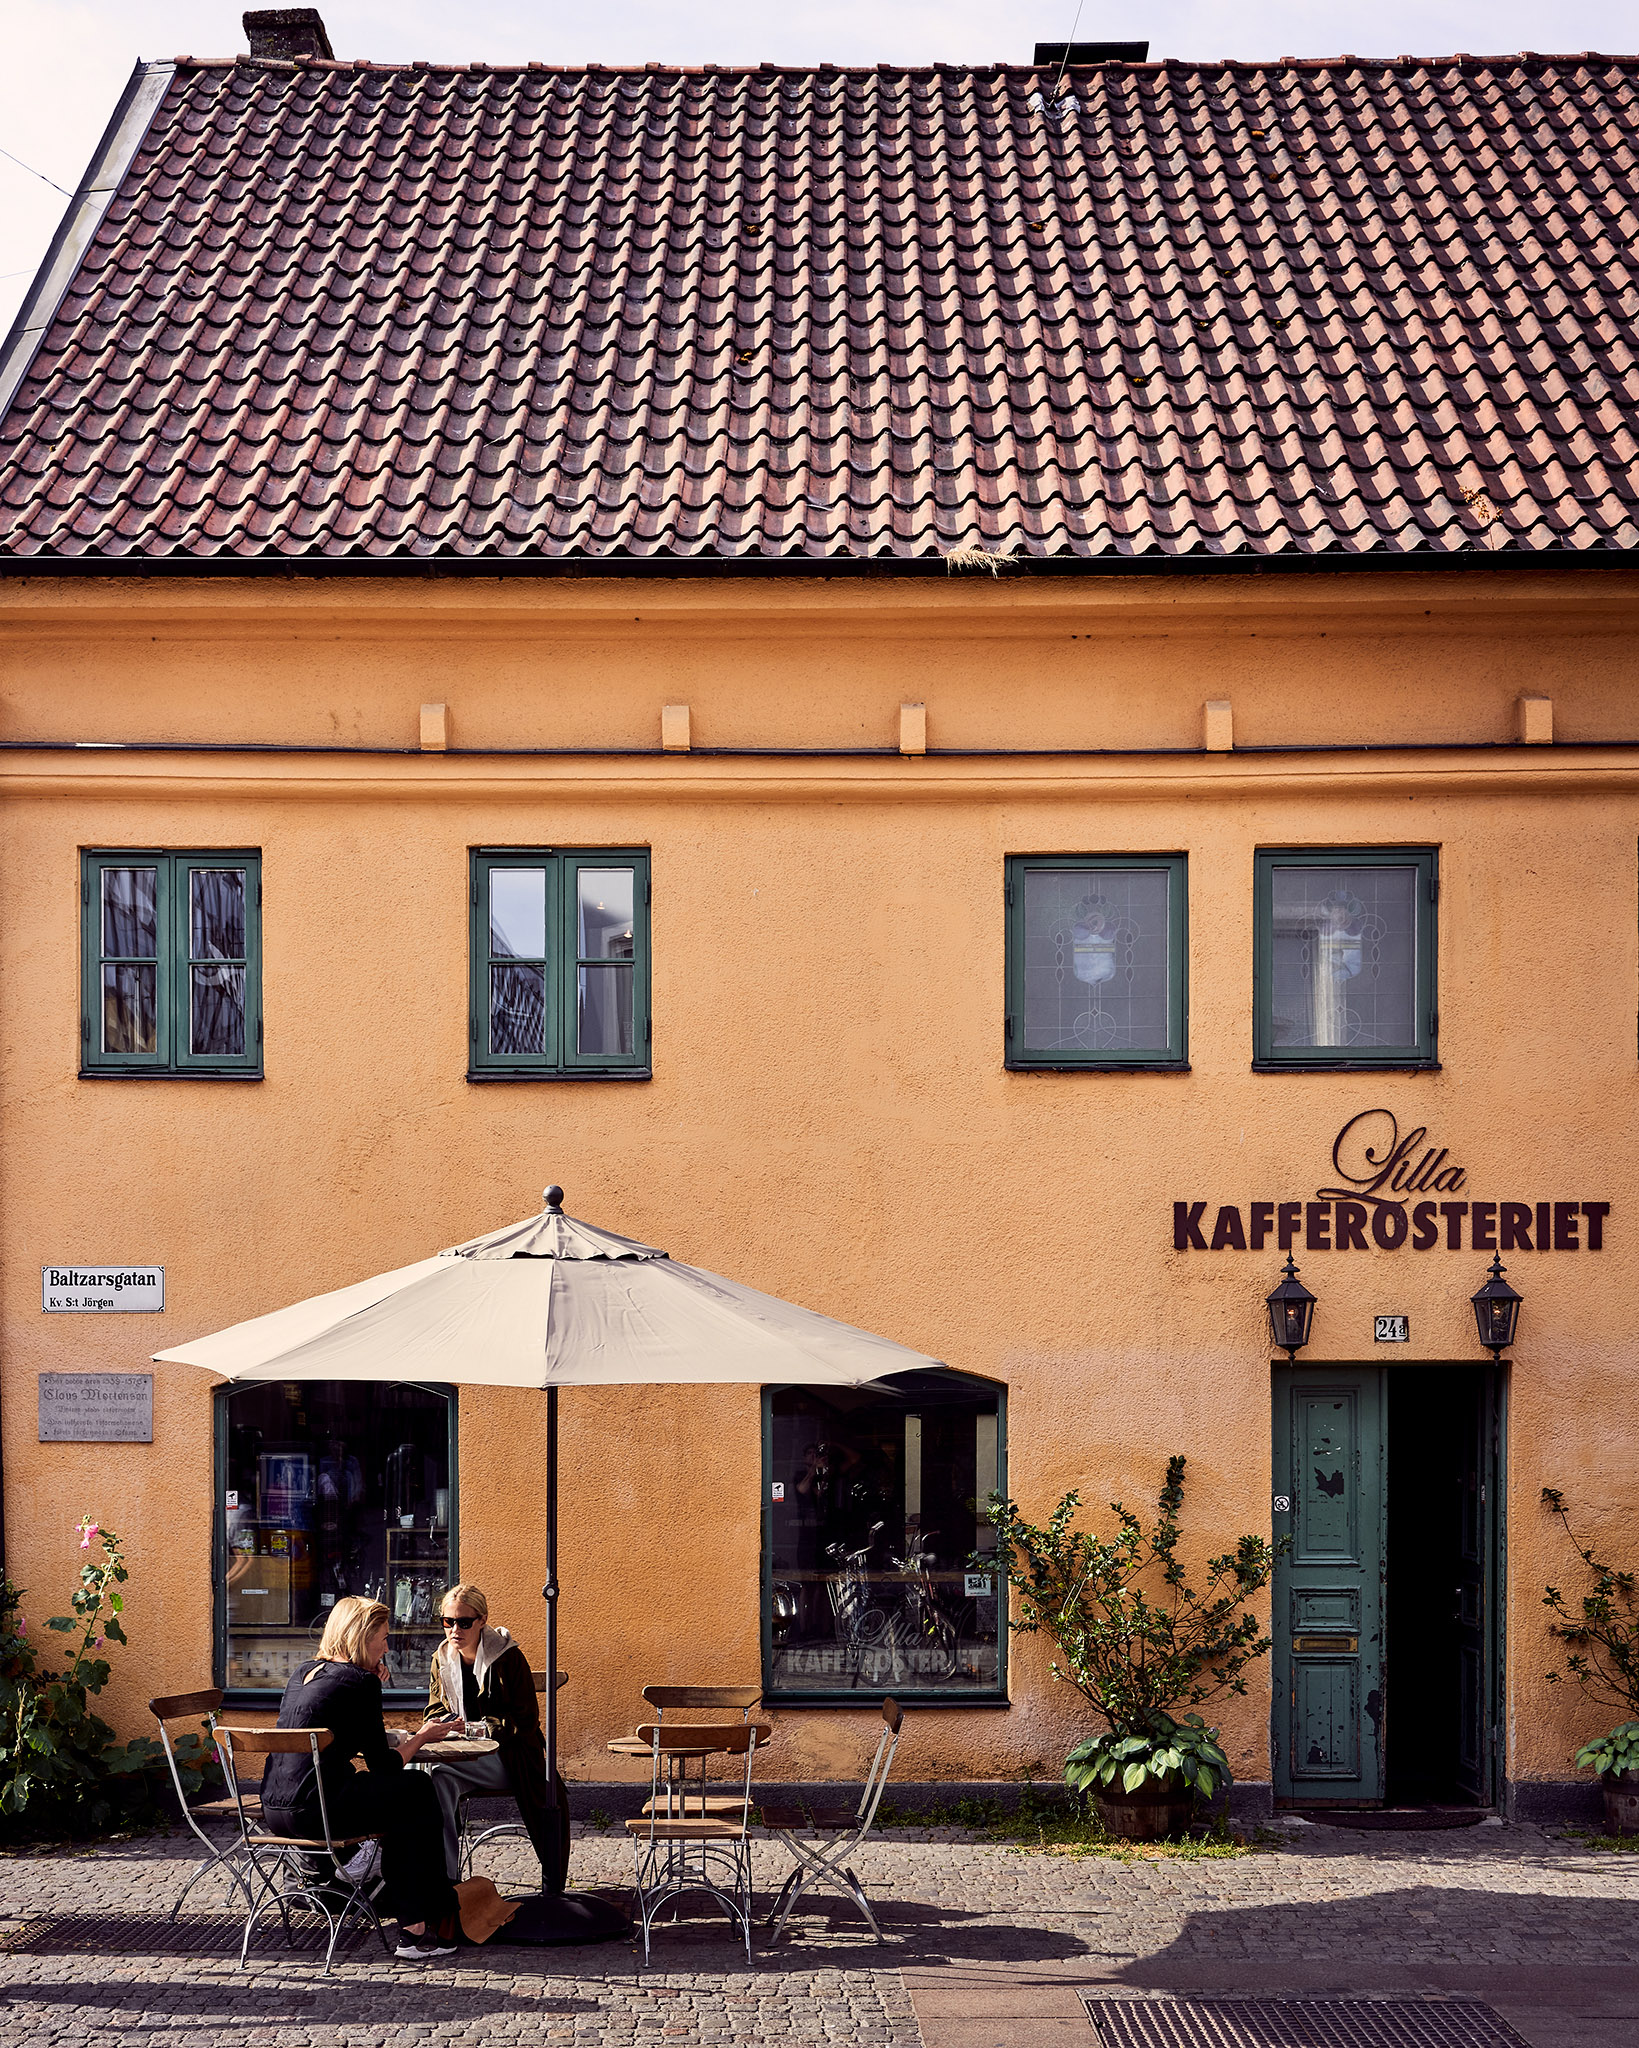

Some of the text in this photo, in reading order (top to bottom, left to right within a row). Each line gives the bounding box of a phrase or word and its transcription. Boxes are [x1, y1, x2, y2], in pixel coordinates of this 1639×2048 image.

[1316, 1108, 1467, 1205] Lilla
[49, 1270, 157, 1291] Baltzarsgatan
[65, 1297, 79, 1308] S:t
[82, 1297, 114, 1310] Jörgen
[1378, 1319, 1406, 1338] 24a
